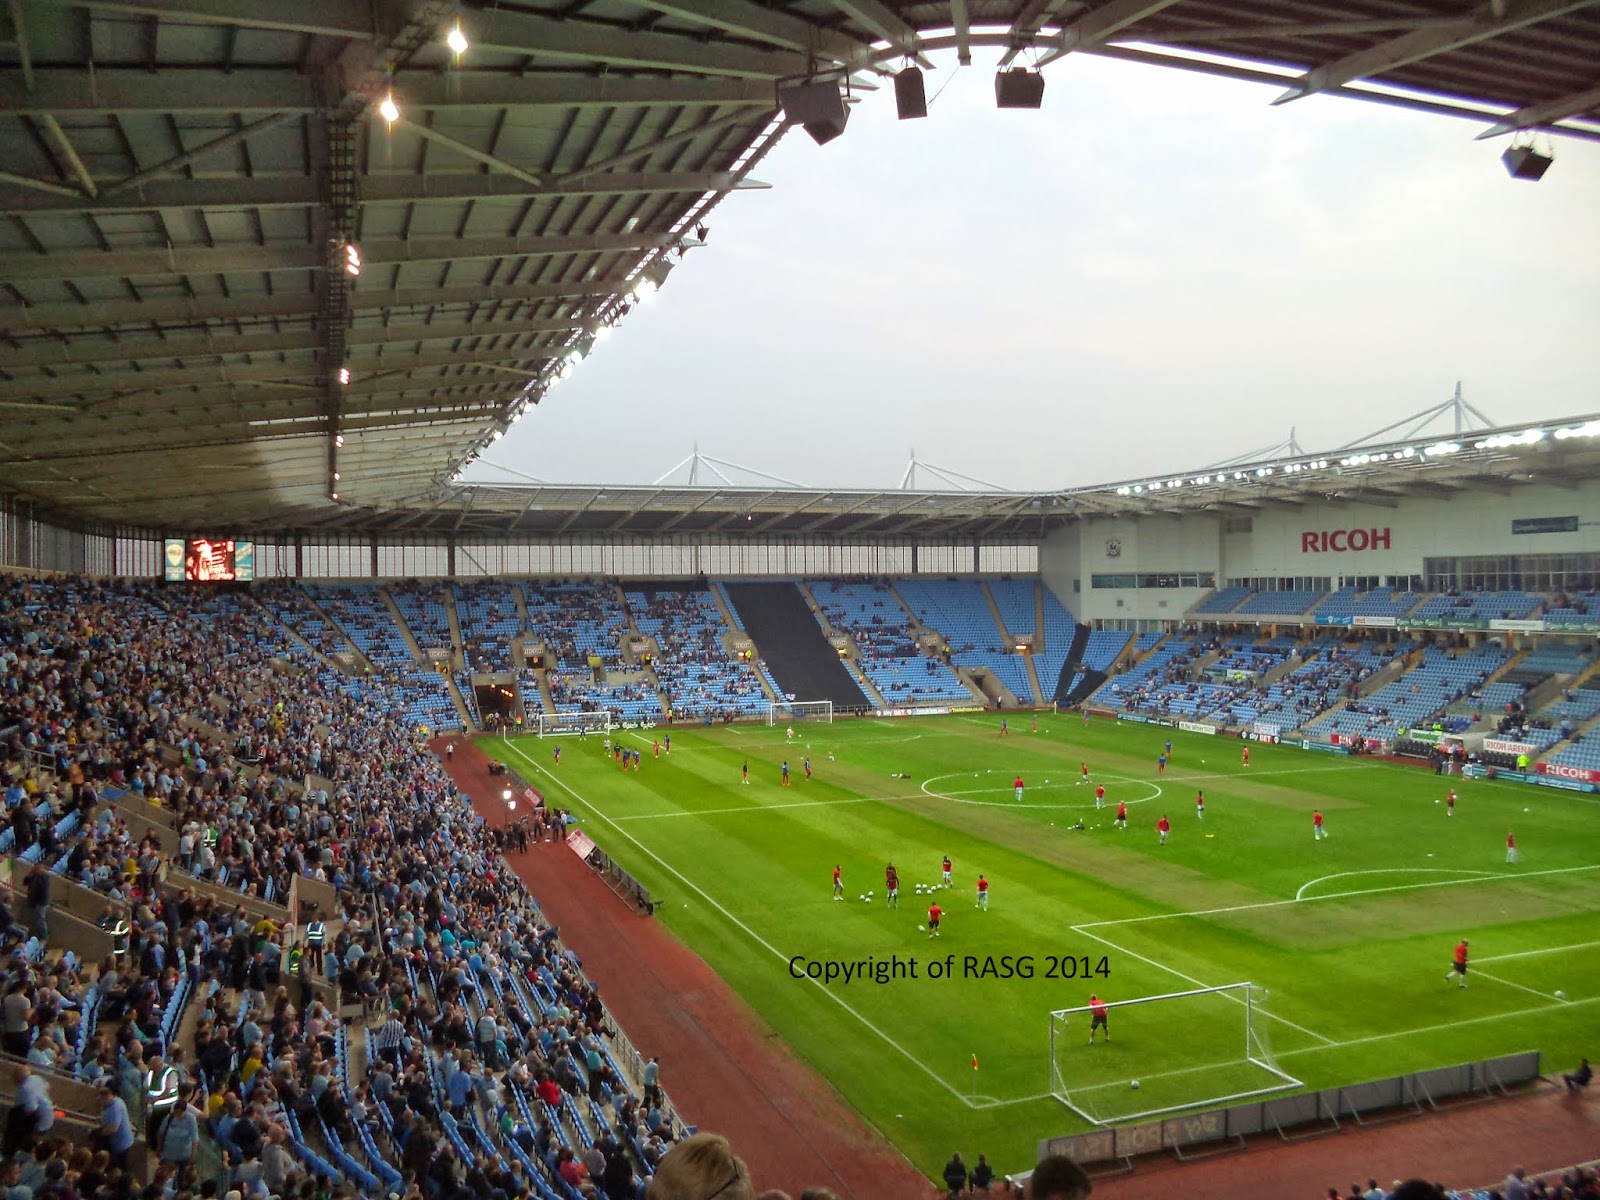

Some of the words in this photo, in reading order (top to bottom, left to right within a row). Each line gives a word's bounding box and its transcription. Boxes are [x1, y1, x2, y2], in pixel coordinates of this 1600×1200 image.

[1302, 528, 1390, 553] RICOH
[1249, 732, 1259, 742] sky
[1260, 734, 1272, 743] BET
[1486, 741, 1506, 750] RICOH
[1508, 743, 1532, 753] ARENA
[1546, 764, 1590, 780] RICOH
